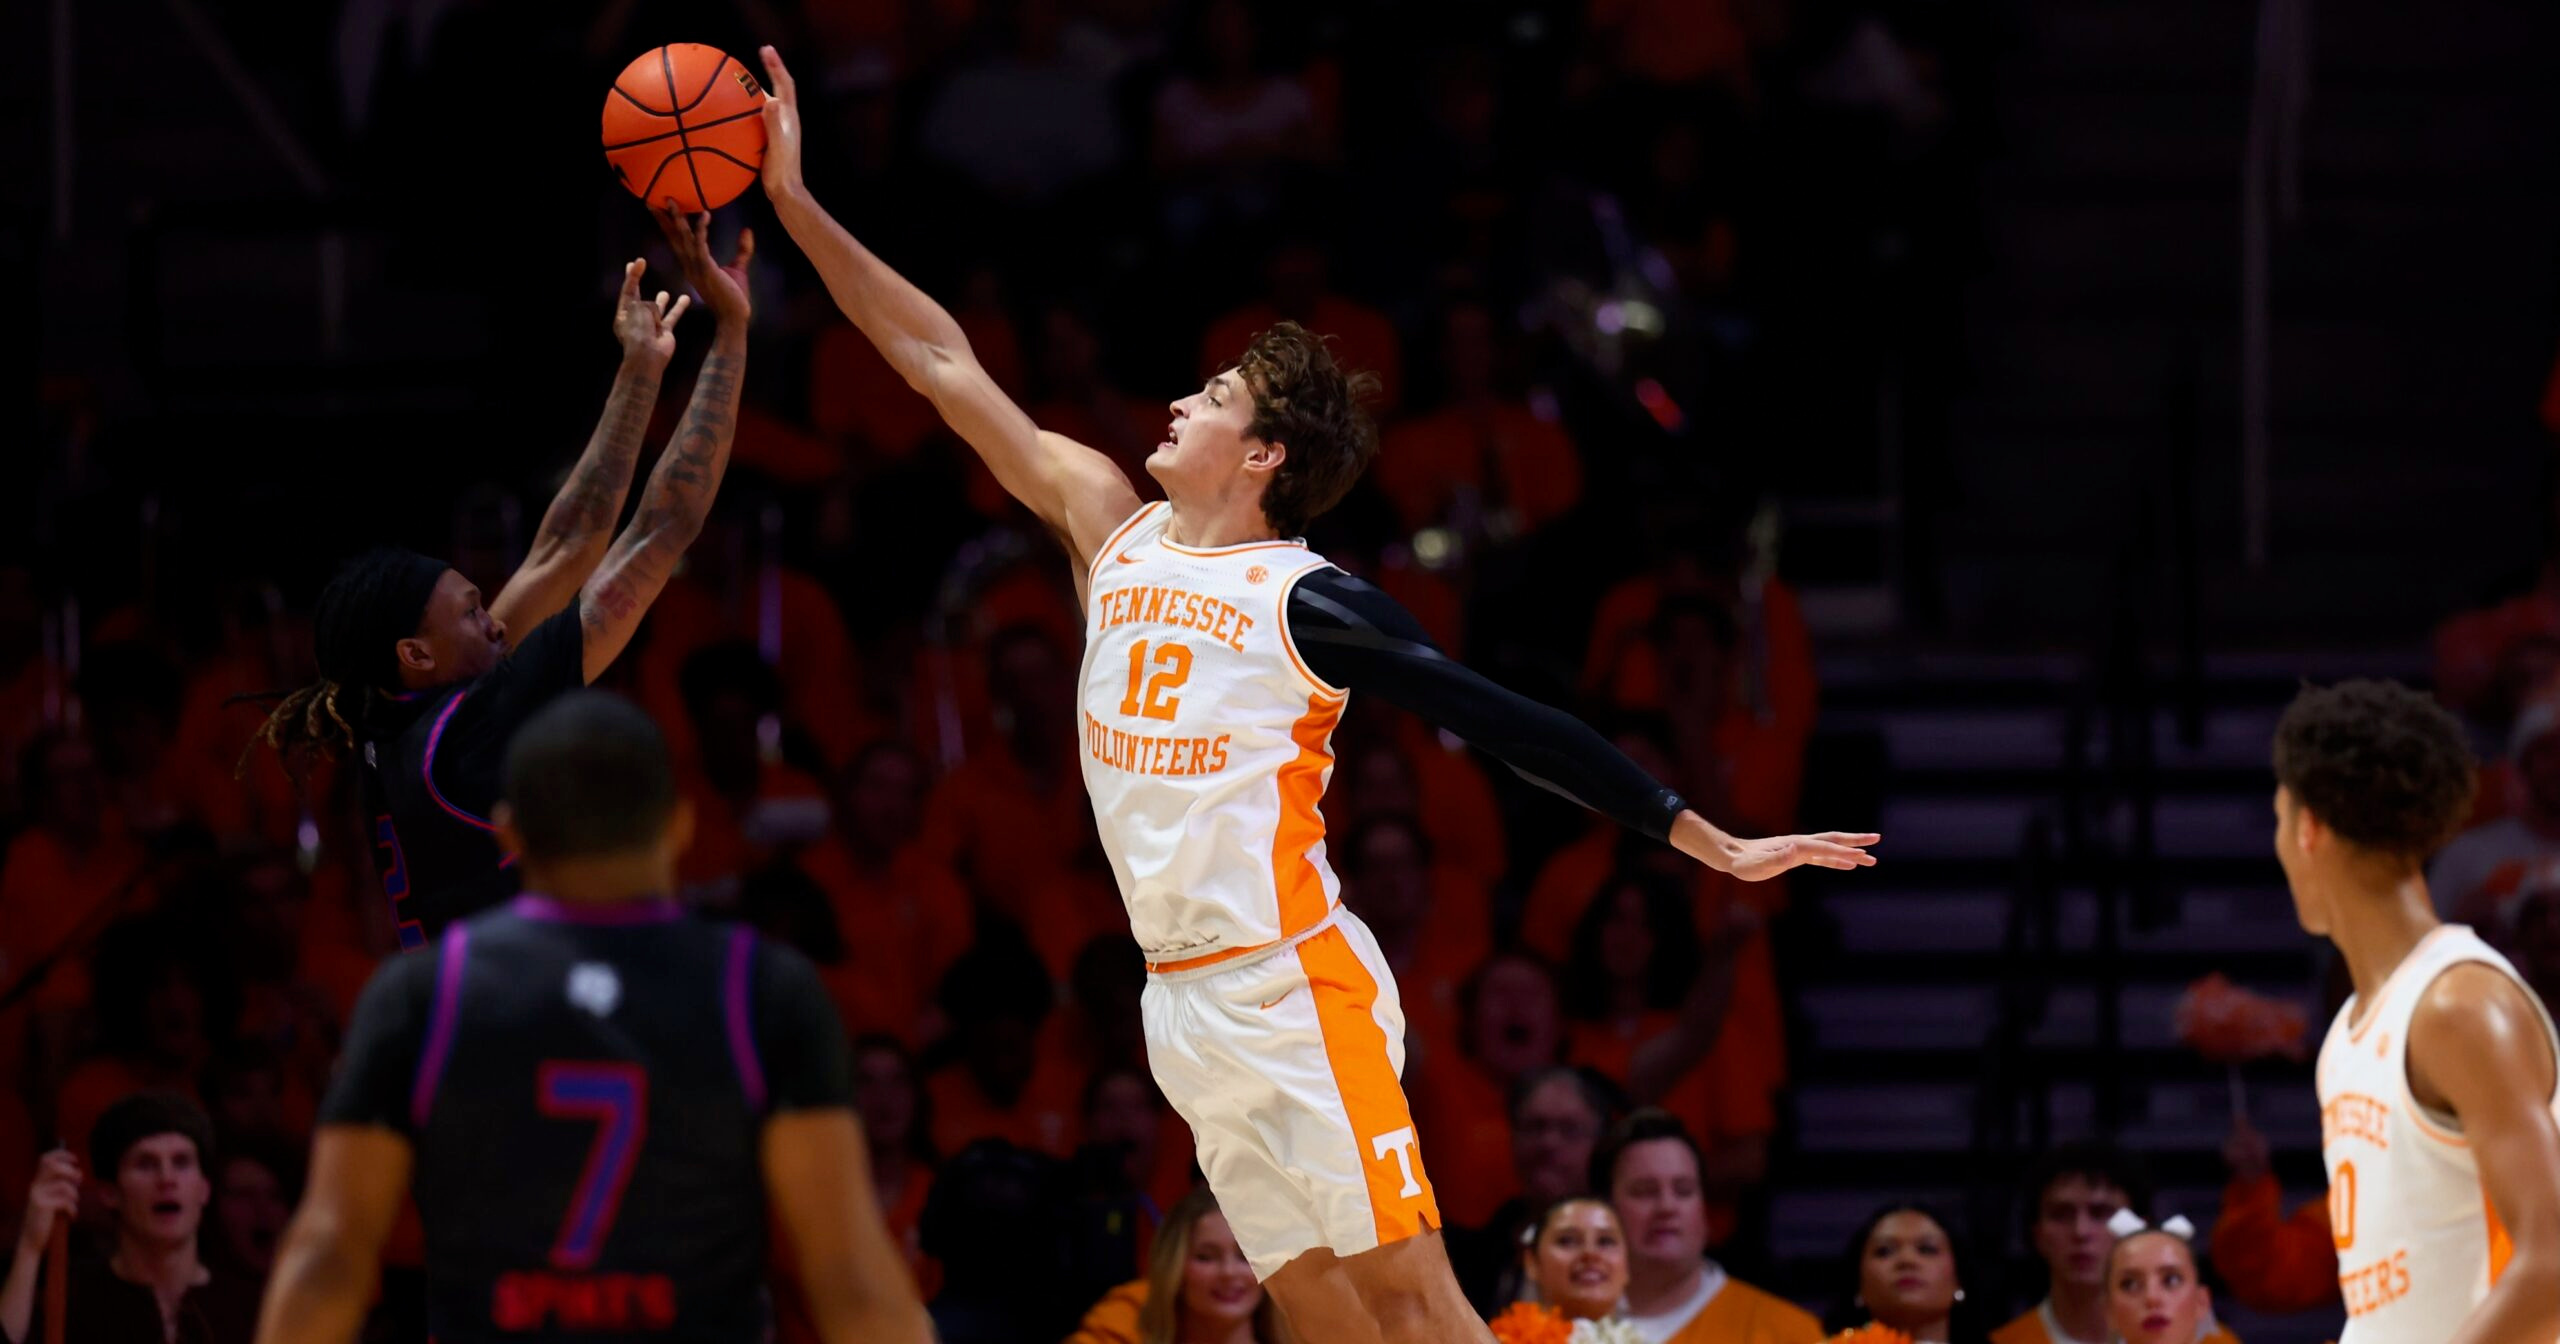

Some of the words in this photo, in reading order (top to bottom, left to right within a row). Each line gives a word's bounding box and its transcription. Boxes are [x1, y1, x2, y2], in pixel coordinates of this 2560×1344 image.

[1100, 587, 1254, 653] TENNESSEE
[1120, 639, 1194, 722] 12
[1085, 711, 1231, 776] VOLUNTEERS
[534, 1058, 650, 1270] 7
[1372, 1126, 1423, 1199] T
